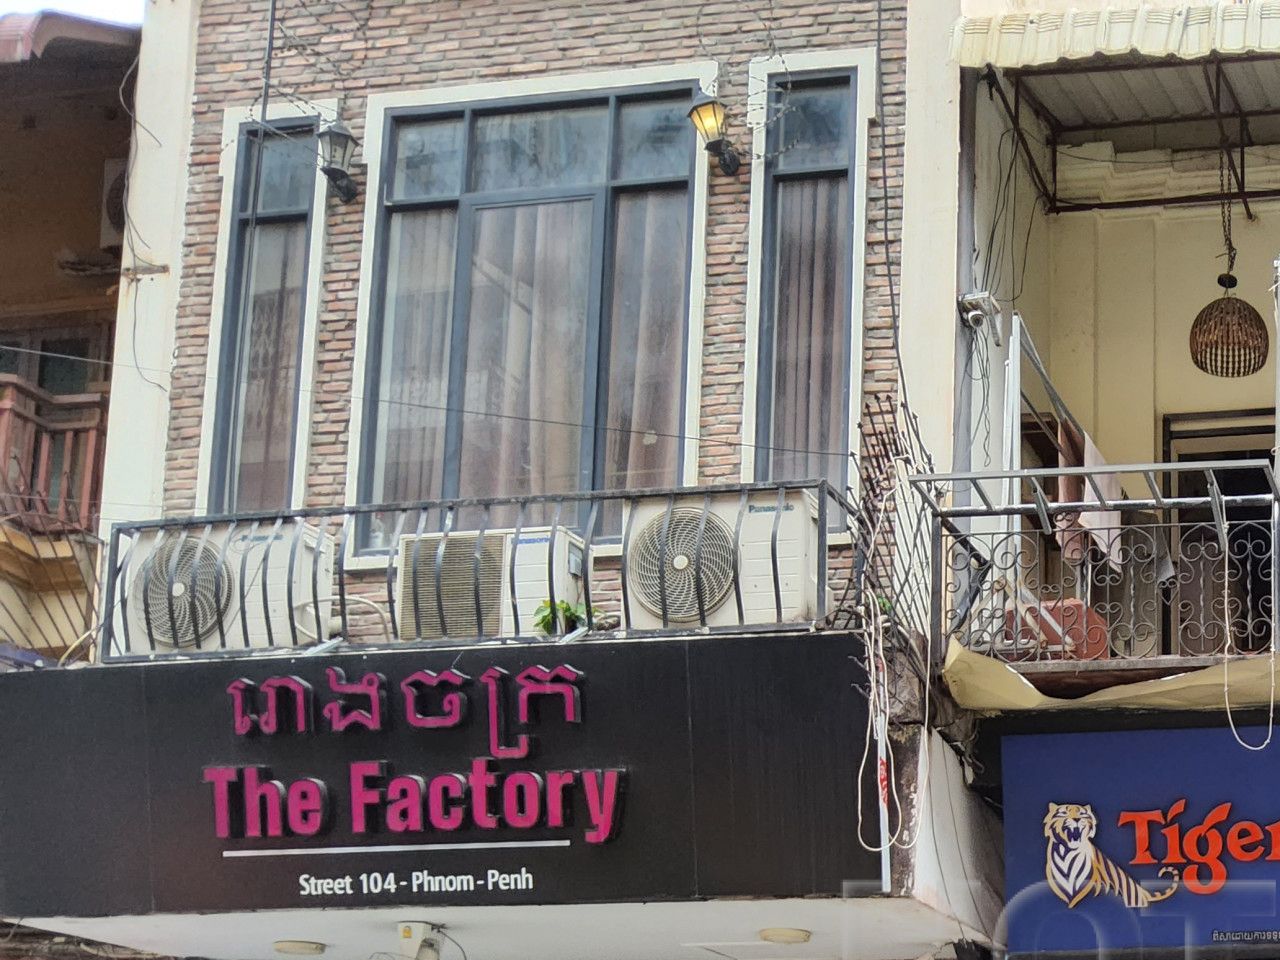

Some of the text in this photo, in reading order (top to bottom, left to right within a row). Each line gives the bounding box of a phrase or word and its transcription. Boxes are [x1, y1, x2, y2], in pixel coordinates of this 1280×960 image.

[227, 665, 582, 758] រោងចក្រ
[203, 757, 625, 844] The Factory
[299, 873, 353, 896] Street
